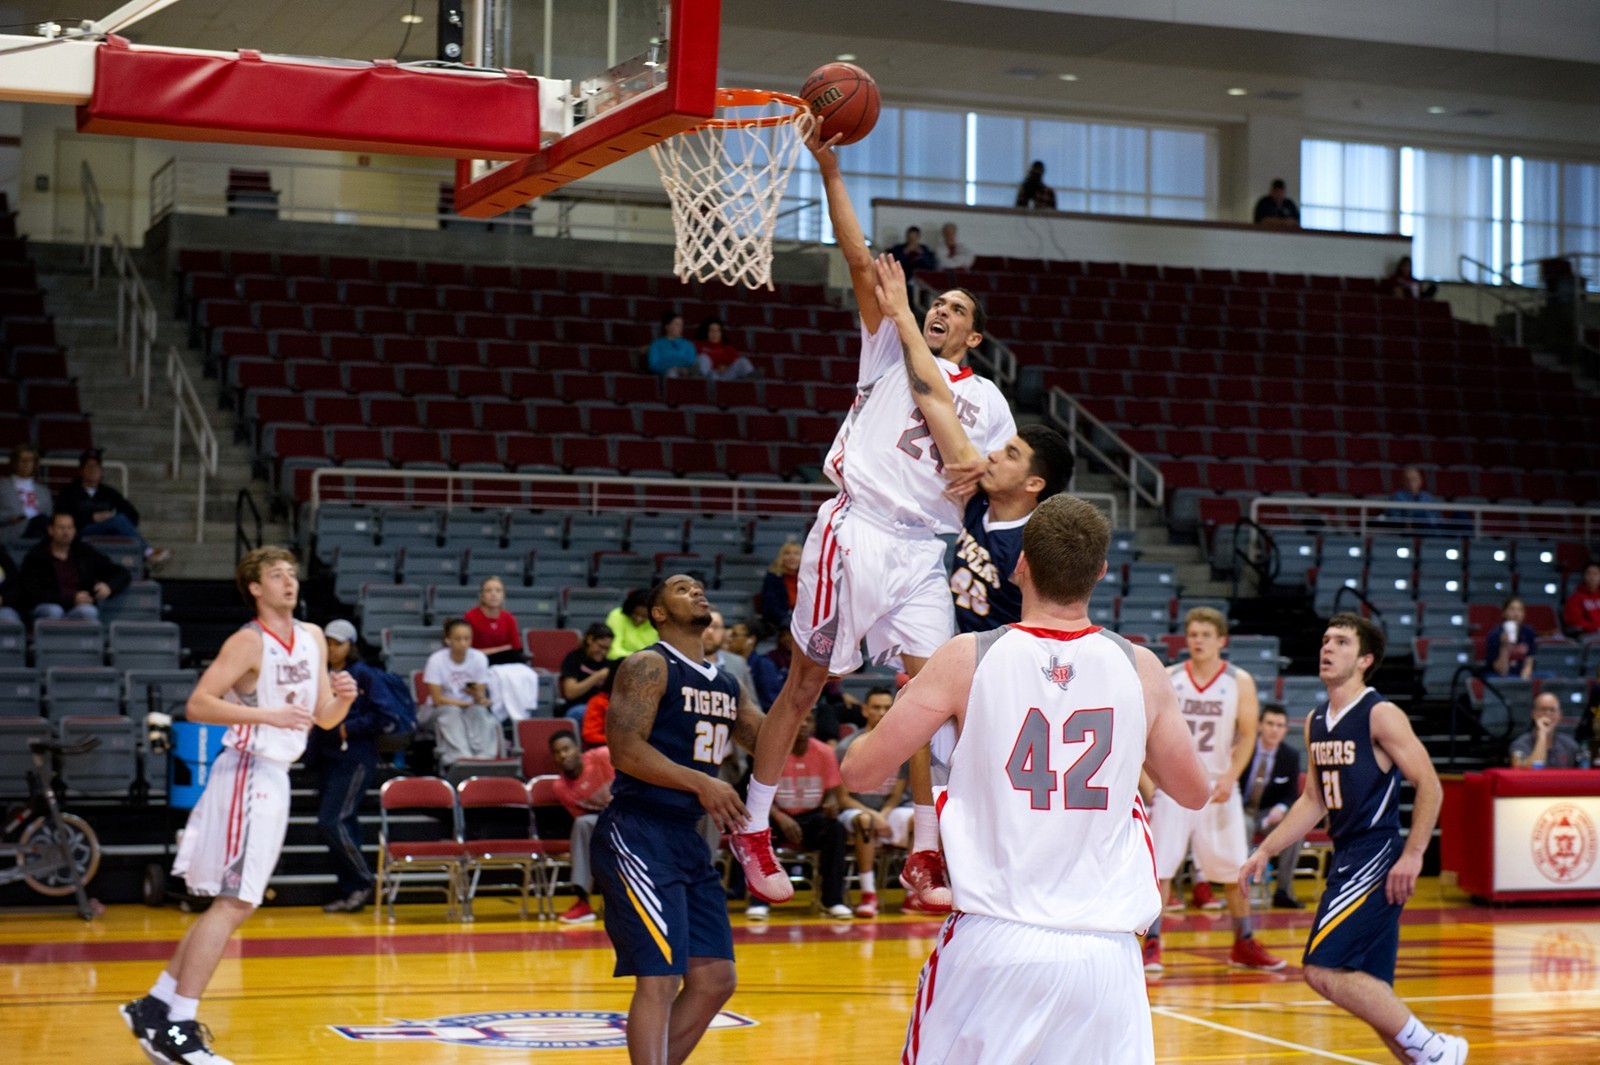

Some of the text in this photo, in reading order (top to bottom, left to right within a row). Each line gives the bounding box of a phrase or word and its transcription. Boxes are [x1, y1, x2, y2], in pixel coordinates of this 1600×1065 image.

[1053, 668, 1069, 681] SR
[681, 686, 737, 721] TIGERS
[1179, 698, 1223, 716] OBOS
[693, 720, 729, 765] 20
[1005, 707, 1114, 810] 42
[1310, 740, 1356, 765] TIGERS
[1321, 770, 1343, 810] 21
